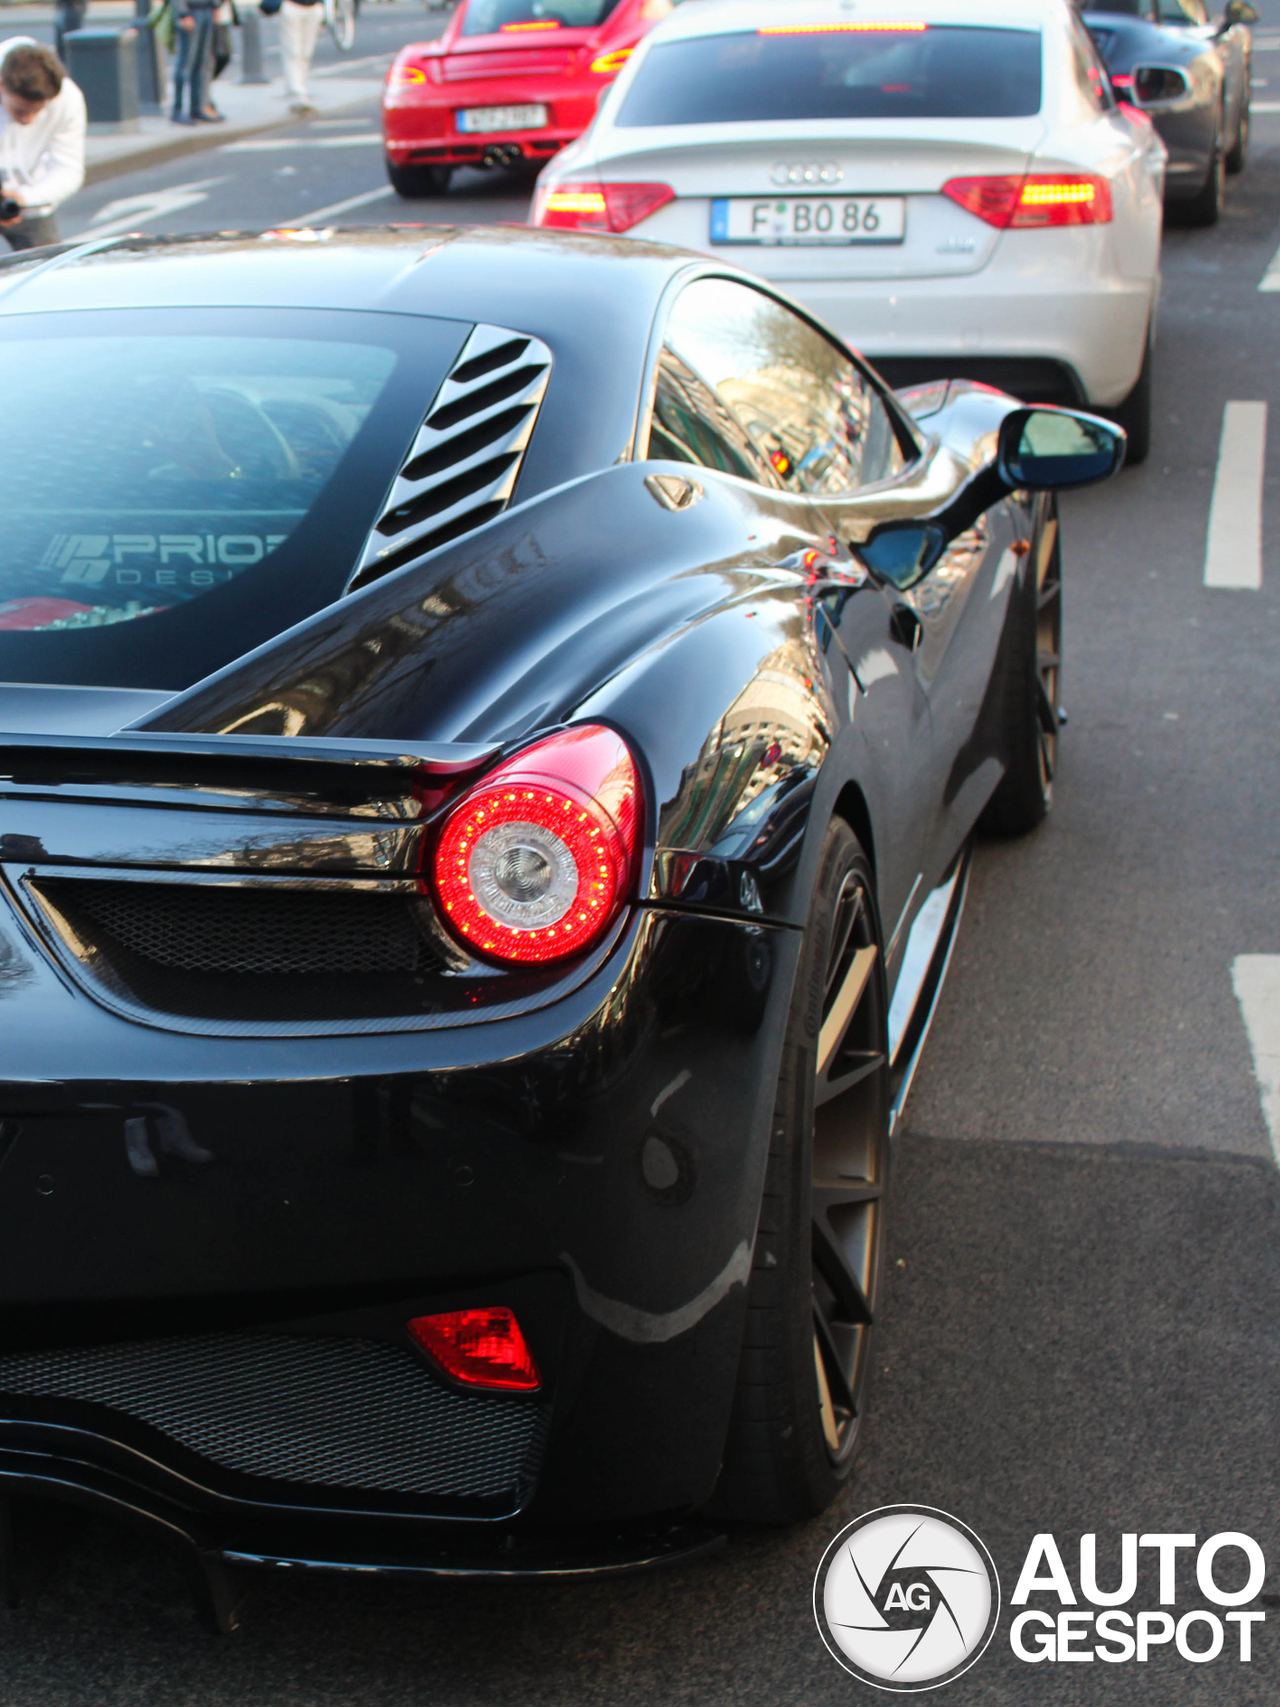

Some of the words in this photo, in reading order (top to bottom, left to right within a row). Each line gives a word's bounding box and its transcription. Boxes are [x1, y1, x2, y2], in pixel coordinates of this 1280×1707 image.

[752, 203, 770, 232] F
[794, 203, 834, 232] BO
[842, 203, 879, 232] 86
